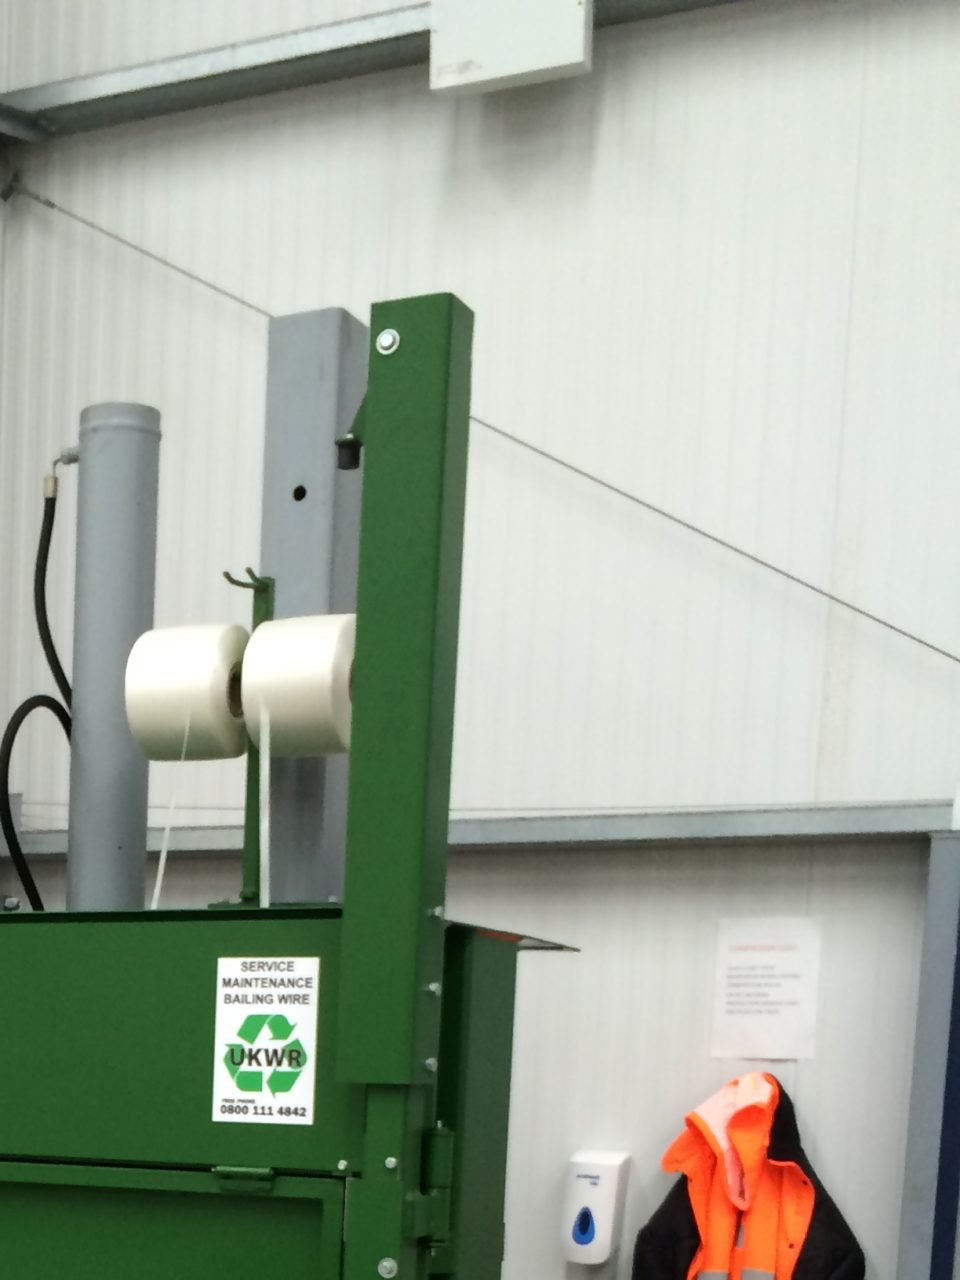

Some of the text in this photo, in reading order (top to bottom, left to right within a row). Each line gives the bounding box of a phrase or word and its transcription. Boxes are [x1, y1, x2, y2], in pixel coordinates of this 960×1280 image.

[240, 961, 295, 972] SERVICE
[222, 977, 313, 989] MAINTENANCE
[224, 994, 310, 1005] BAILING WIRE
[230, 1048, 302, 1068] UKWR
[220, 1104, 307, 1118] 0800 111 4842
